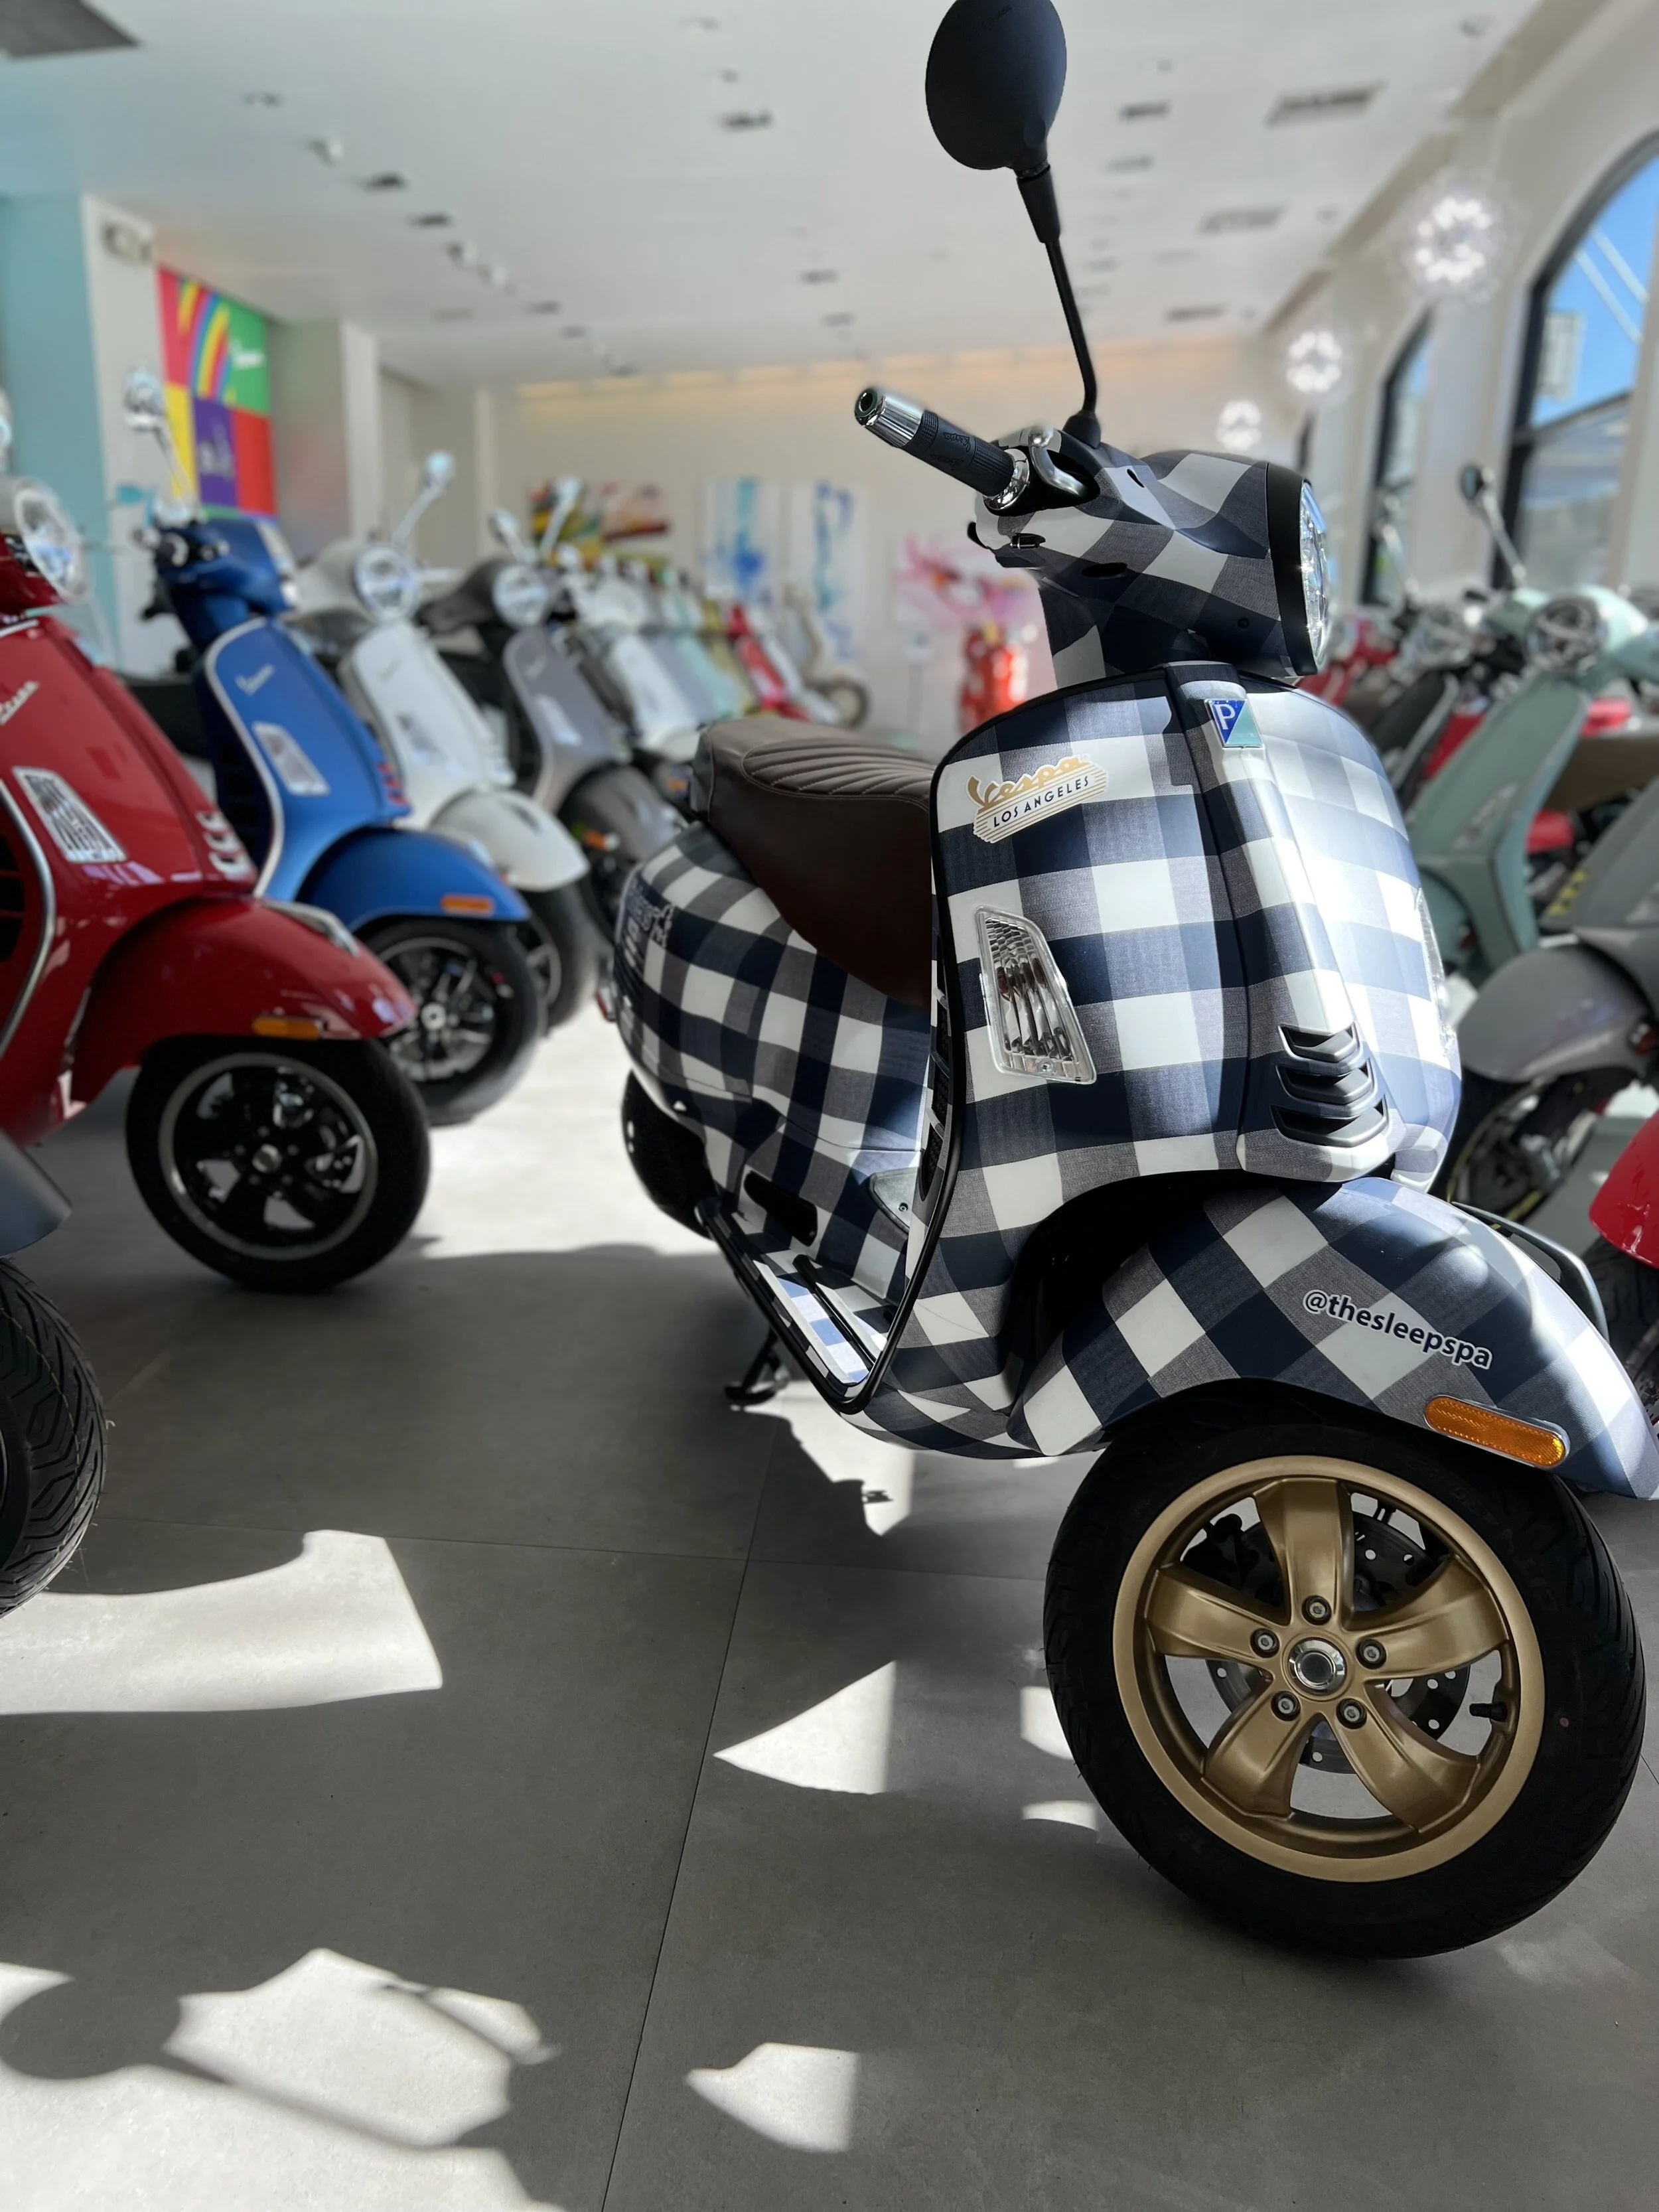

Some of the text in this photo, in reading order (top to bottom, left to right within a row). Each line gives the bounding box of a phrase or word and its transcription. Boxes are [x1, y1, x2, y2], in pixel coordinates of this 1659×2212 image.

[1213, 703, 1236, 730] P
[967, 757, 1090, 812] Vespa
[993, 775, 1089, 828] LOS ANGELES
[1304, 1290, 1491, 1368] @thesleepspa
